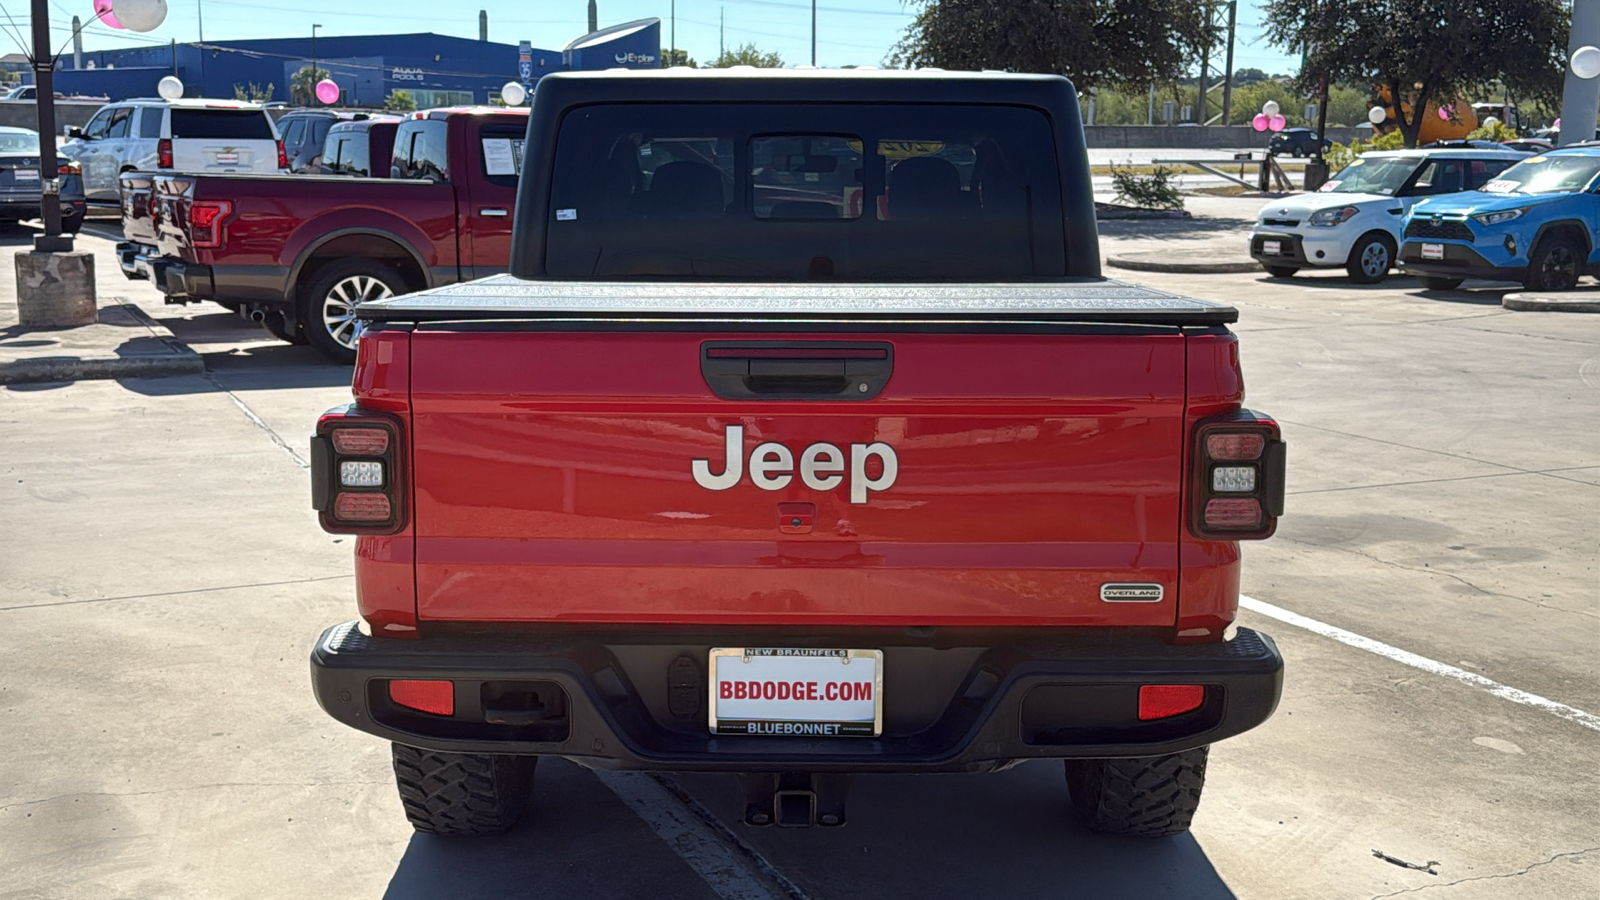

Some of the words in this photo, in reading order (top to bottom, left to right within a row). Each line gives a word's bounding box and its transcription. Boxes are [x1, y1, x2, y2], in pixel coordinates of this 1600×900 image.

[691, 424, 899, 504] Jeep
[777, 649, 846, 657] BRAUNFELS
[719, 681, 872, 701] BBDODGE.COM
[747, 722, 841, 735] BLUEBONNET
